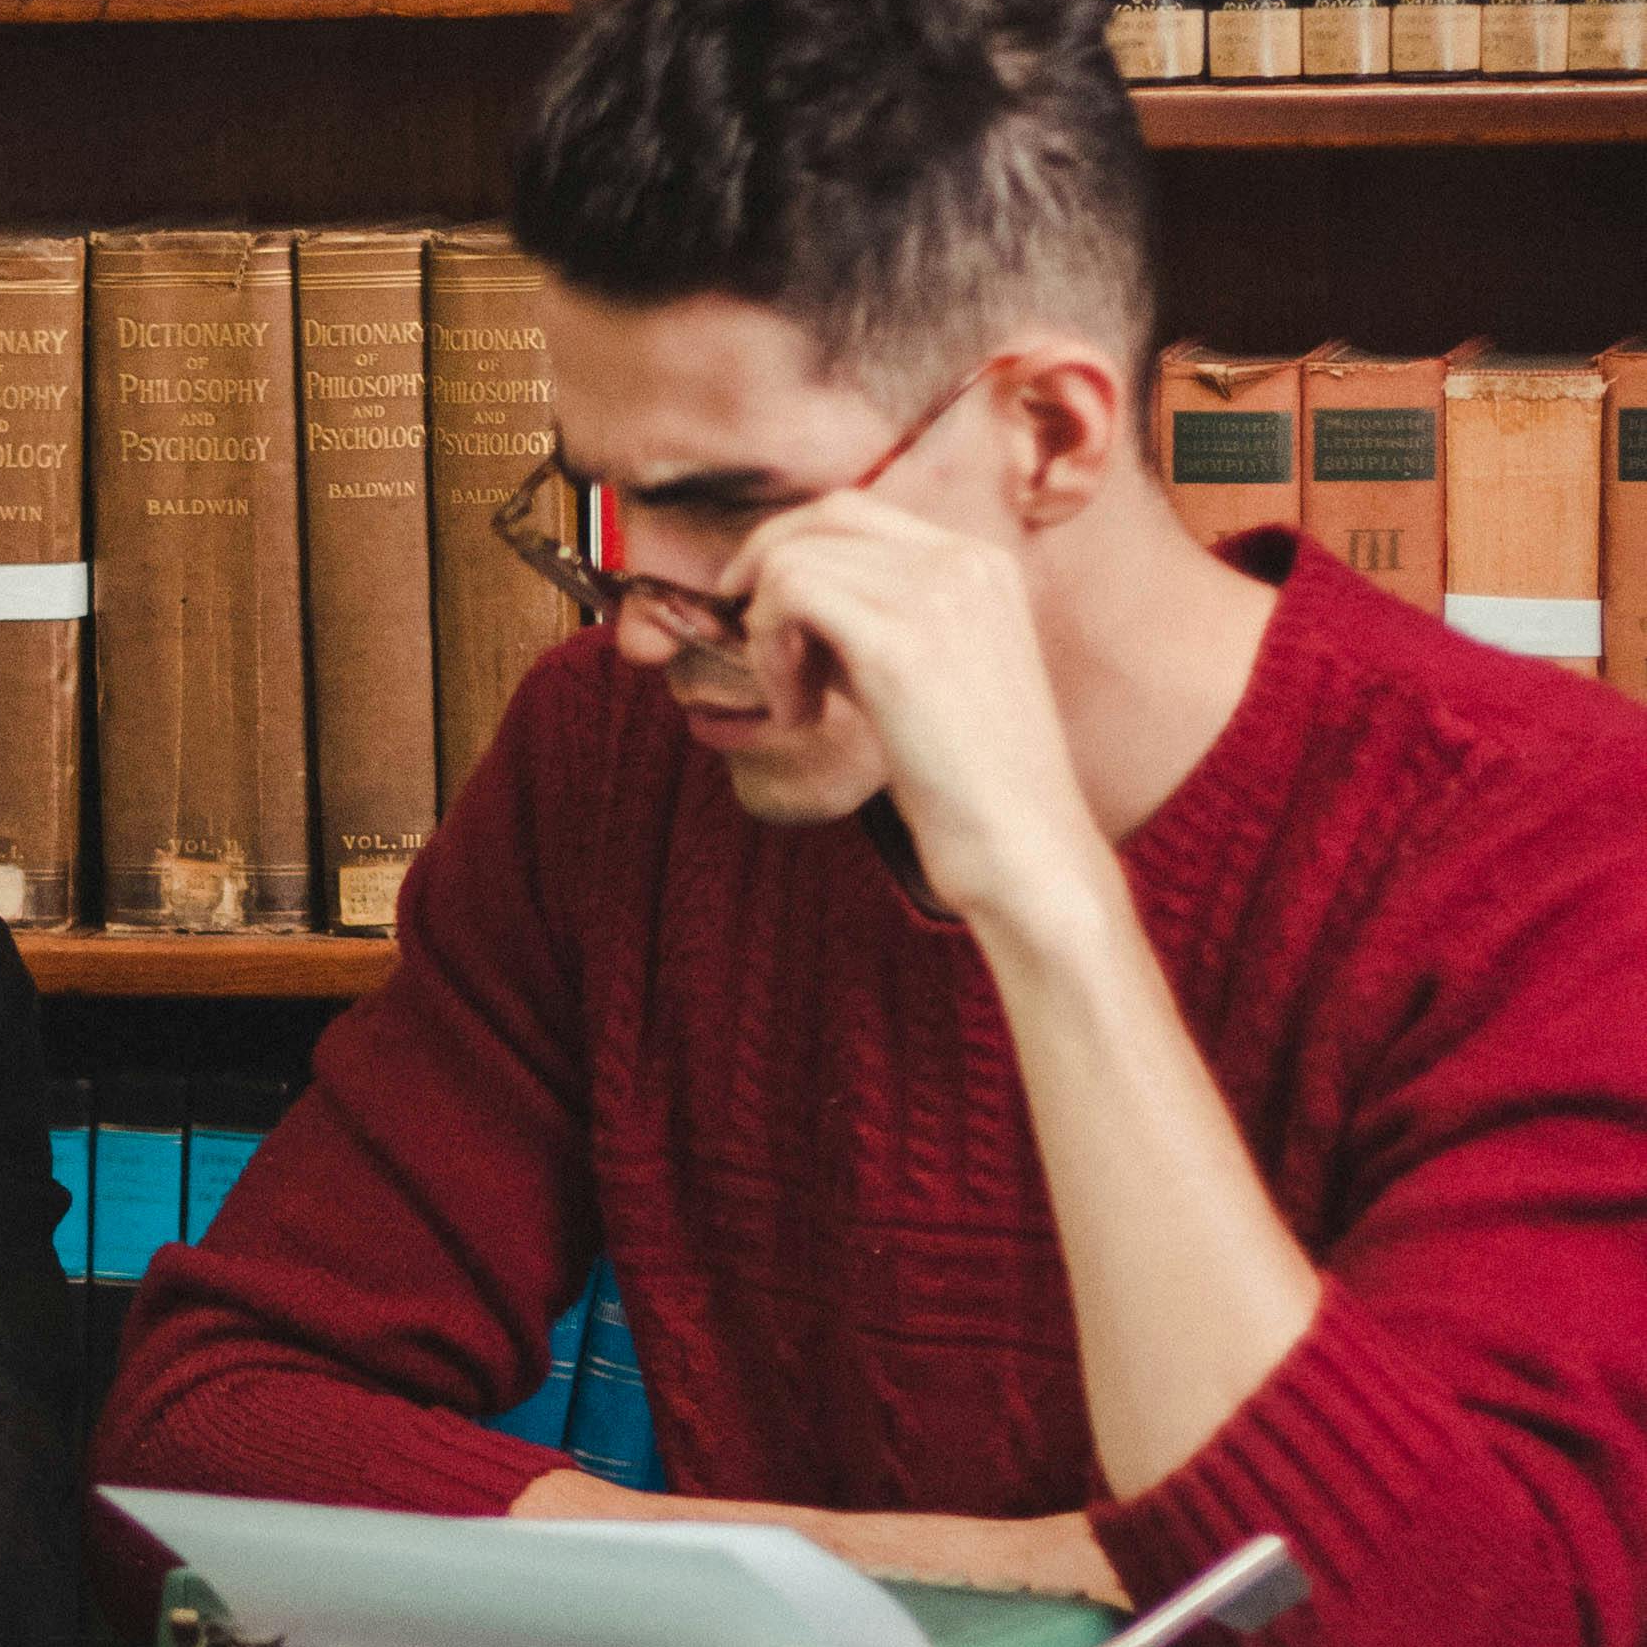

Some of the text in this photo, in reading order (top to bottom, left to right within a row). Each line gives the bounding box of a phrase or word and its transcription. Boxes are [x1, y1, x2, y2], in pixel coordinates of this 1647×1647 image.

[117, 317, 270, 350] DICTIONARY
[431, 323, 546, 351] DICTIONARY
[186, 357, 210, 371] OF
[355, 354, 379, 366] OF
[478, 359, 500, 371] OF
[118, 373, 271, 403] PHILOSOPHY
[433, 376, 552, 404] PHILOSOPHY
[178, 413, 216, 427] AND
[353, 405, 385, 419] AND
[474, 412, 506, 425] AND
[120, 429, 271, 462] PSYCHOLOGY
[435, 427, 552, 455] PSYCHOLOGY
[328, 481, 417, 499] BALDWIN
[147, 499, 249, 516] BALDWIN
